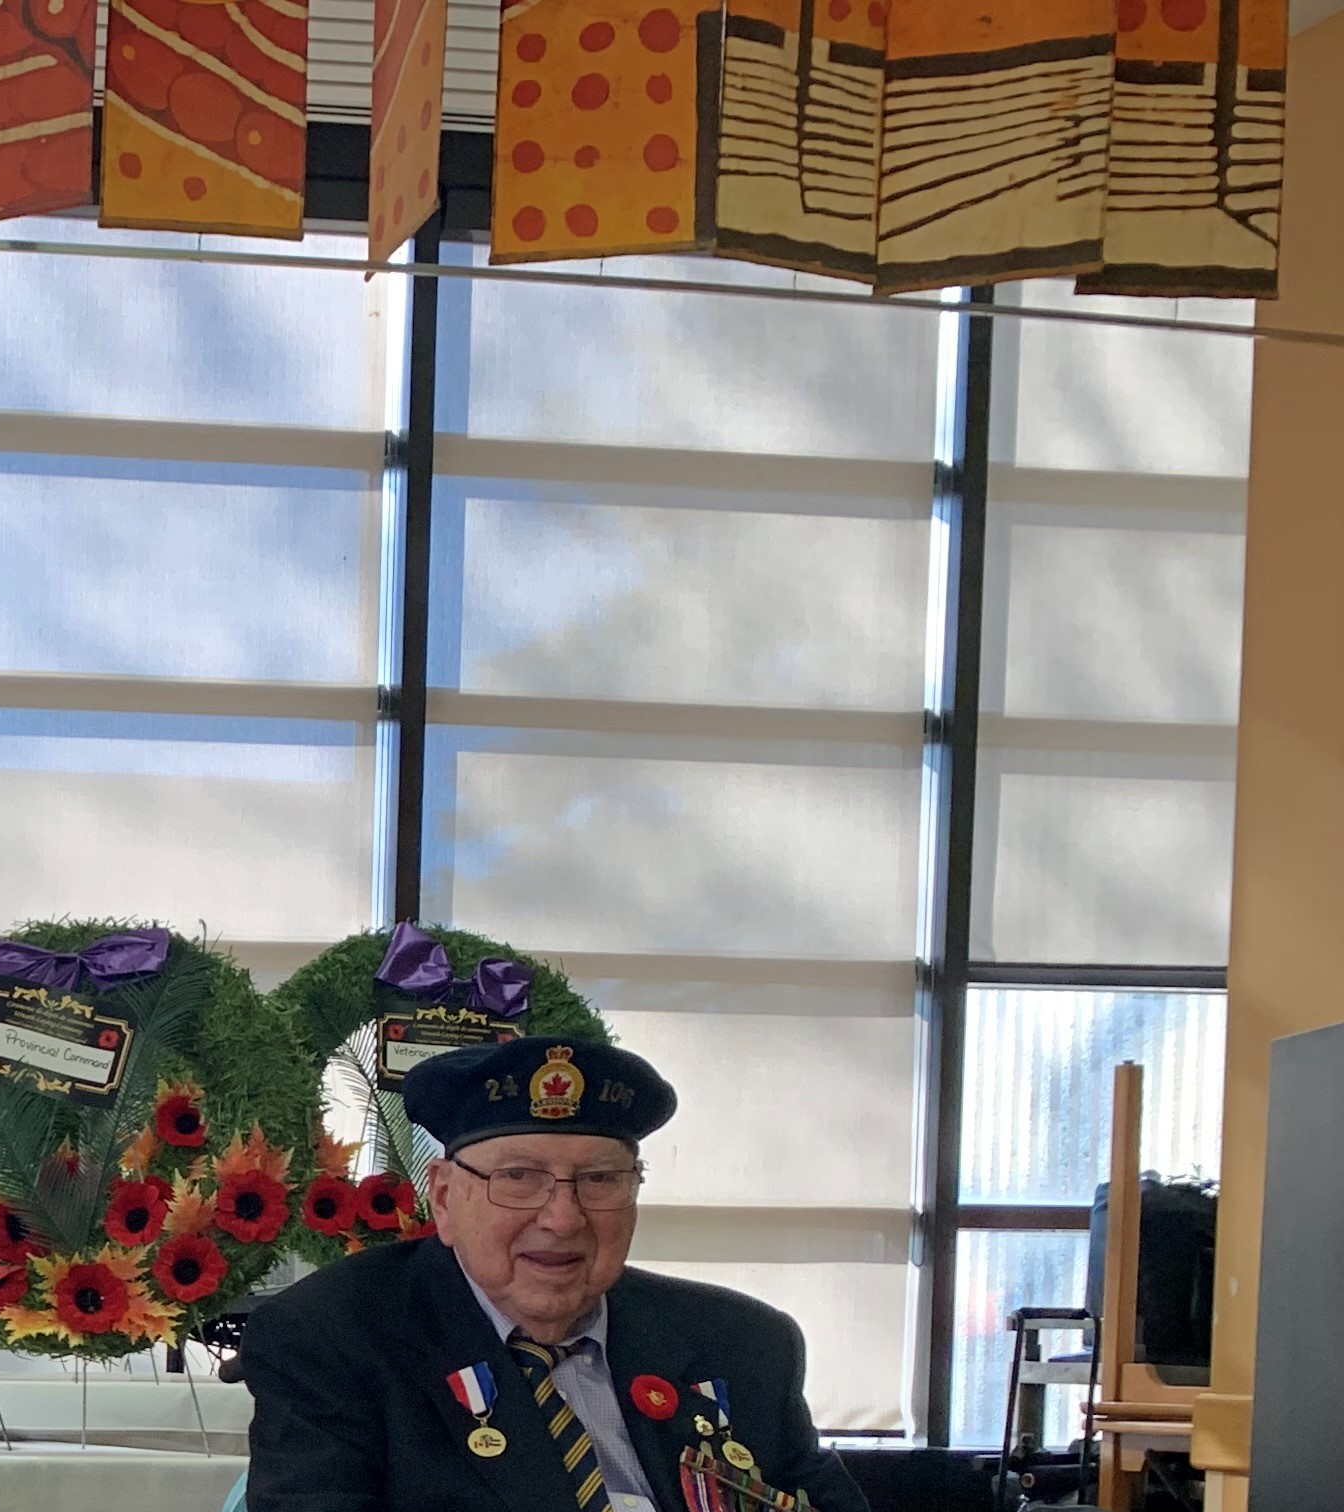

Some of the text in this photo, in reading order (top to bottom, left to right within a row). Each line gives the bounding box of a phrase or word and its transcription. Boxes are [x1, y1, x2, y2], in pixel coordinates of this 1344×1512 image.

[5, 1028, 60, 1058] Provincial
[63, 1047, 110, 1070] Command
[484, 1074, 519, 1102] 24
